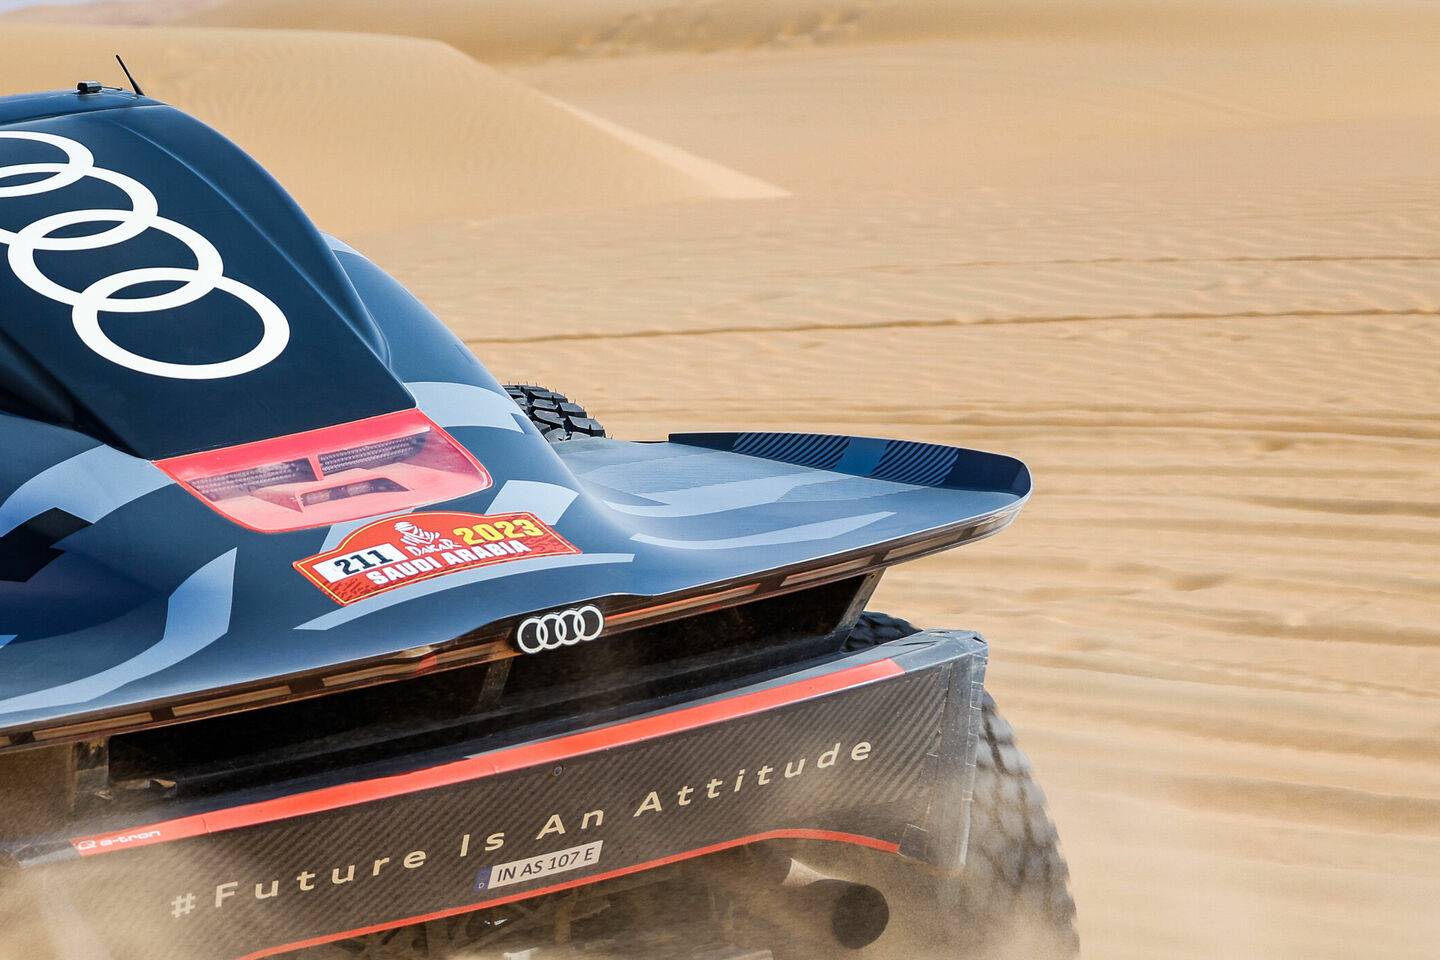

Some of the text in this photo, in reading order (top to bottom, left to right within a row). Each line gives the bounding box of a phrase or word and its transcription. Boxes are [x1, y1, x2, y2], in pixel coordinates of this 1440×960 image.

[453, 518, 545, 546] 2023
[404, 538, 463, 557] DAKAR
[333, 549, 394, 576] 211
[365, 540, 532, 586] SAUDI ARABIA
[100, 829, 161, 847] e-tron
[170, 740, 872, 919] #Future Is An Attitude
[496, 866, 517, 883] IN
[520, 860, 543, 877] AS
[547, 850, 580, 871] 107
[584, 847, 595, 861] E
